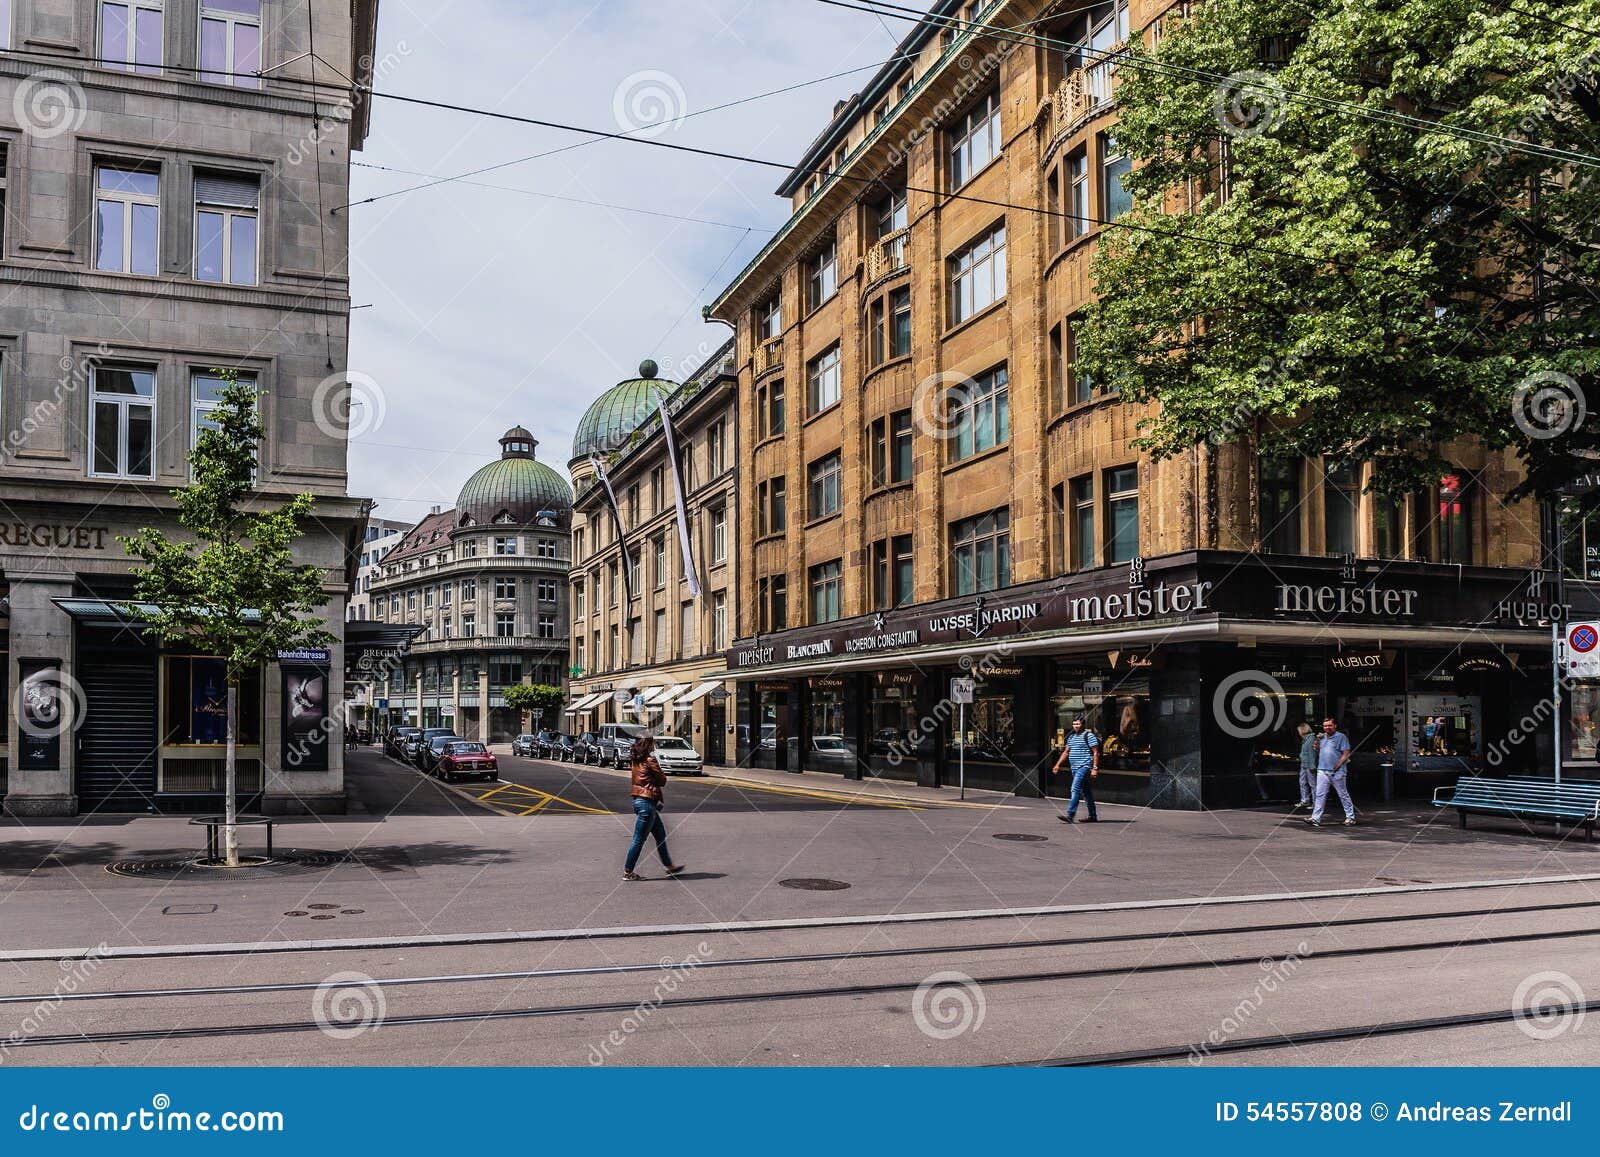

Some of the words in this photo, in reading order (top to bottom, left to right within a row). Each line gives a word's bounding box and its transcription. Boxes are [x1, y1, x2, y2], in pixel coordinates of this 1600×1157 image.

[1131, 556, 1143, 570] 18
[1129, 571, 1143, 584] 81
[1070, 581, 1212, 623] meister
[1275, 582, 1418, 615] meister
[930, 614, 973, 632] ULYSSE
[982, 604, 1037, 625] NARDIN
[1500, 601, 1572, 620] HUBLOT
[787, 639, 832, 659] BLANCPAIN
[845, 635, 877, 653] VACHERON
[877, 629, 918, 648] CONSTANTIN
[739, 646, 773, 666] meister
[1332, 655, 1381, 668] HUBLOT
